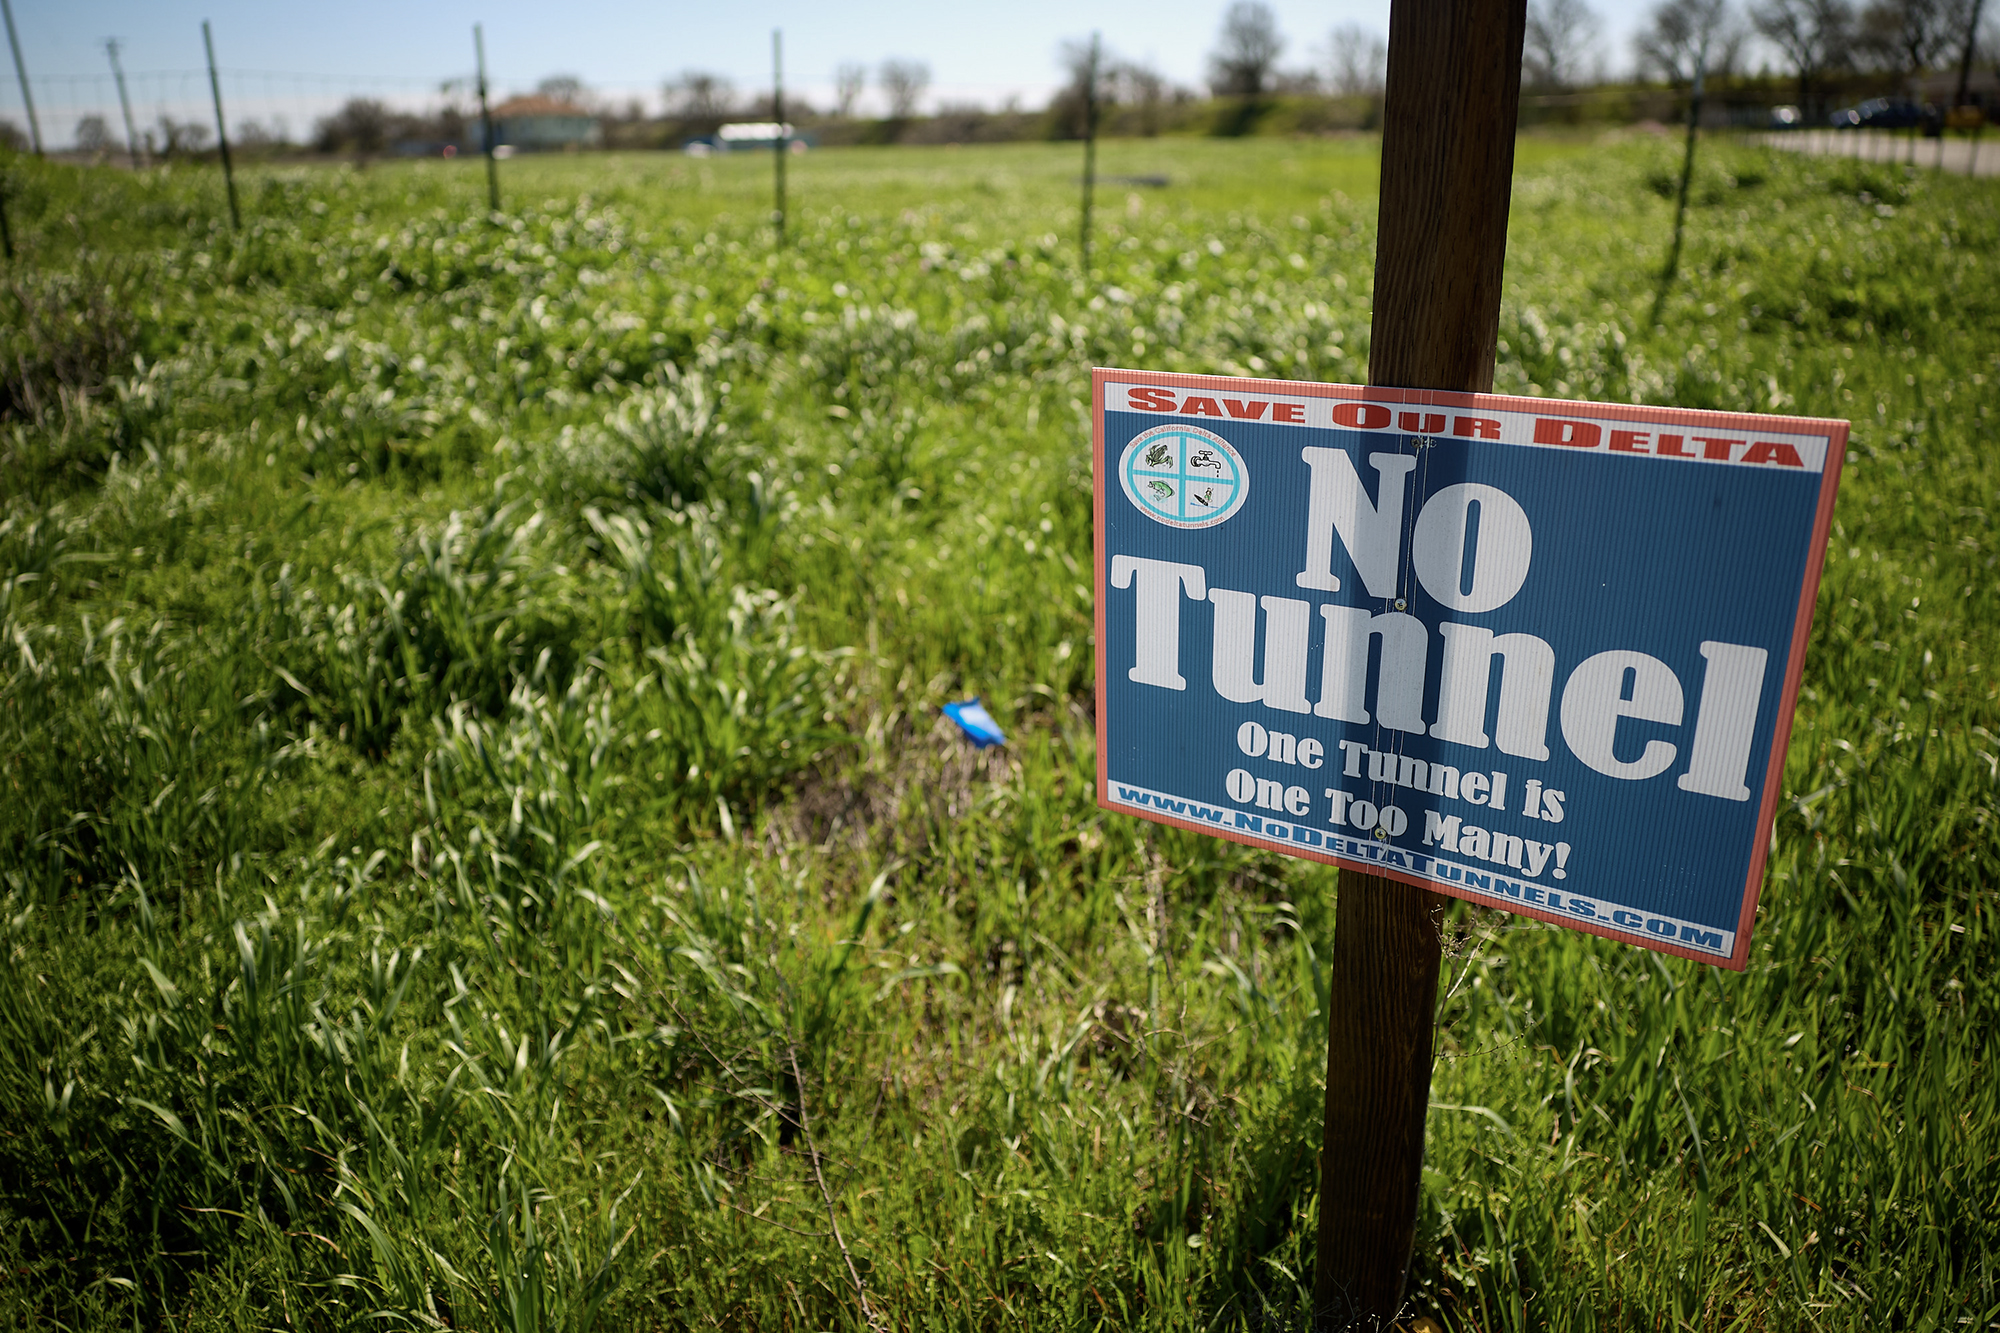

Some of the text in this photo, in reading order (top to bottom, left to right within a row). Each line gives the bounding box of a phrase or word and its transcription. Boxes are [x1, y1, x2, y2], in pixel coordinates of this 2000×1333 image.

[1127, 387, 1805, 468] SAVE OUR DELTA
[1129, 425, 1236, 457] Save the California Delta Alliance
[1296, 445, 1533, 613] No
[1110, 554, 1768, 802] Tunnel
[1225, 768, 1572, 880] One Too Many!
[1236, 721, 1567, 824] One Tunnel is
